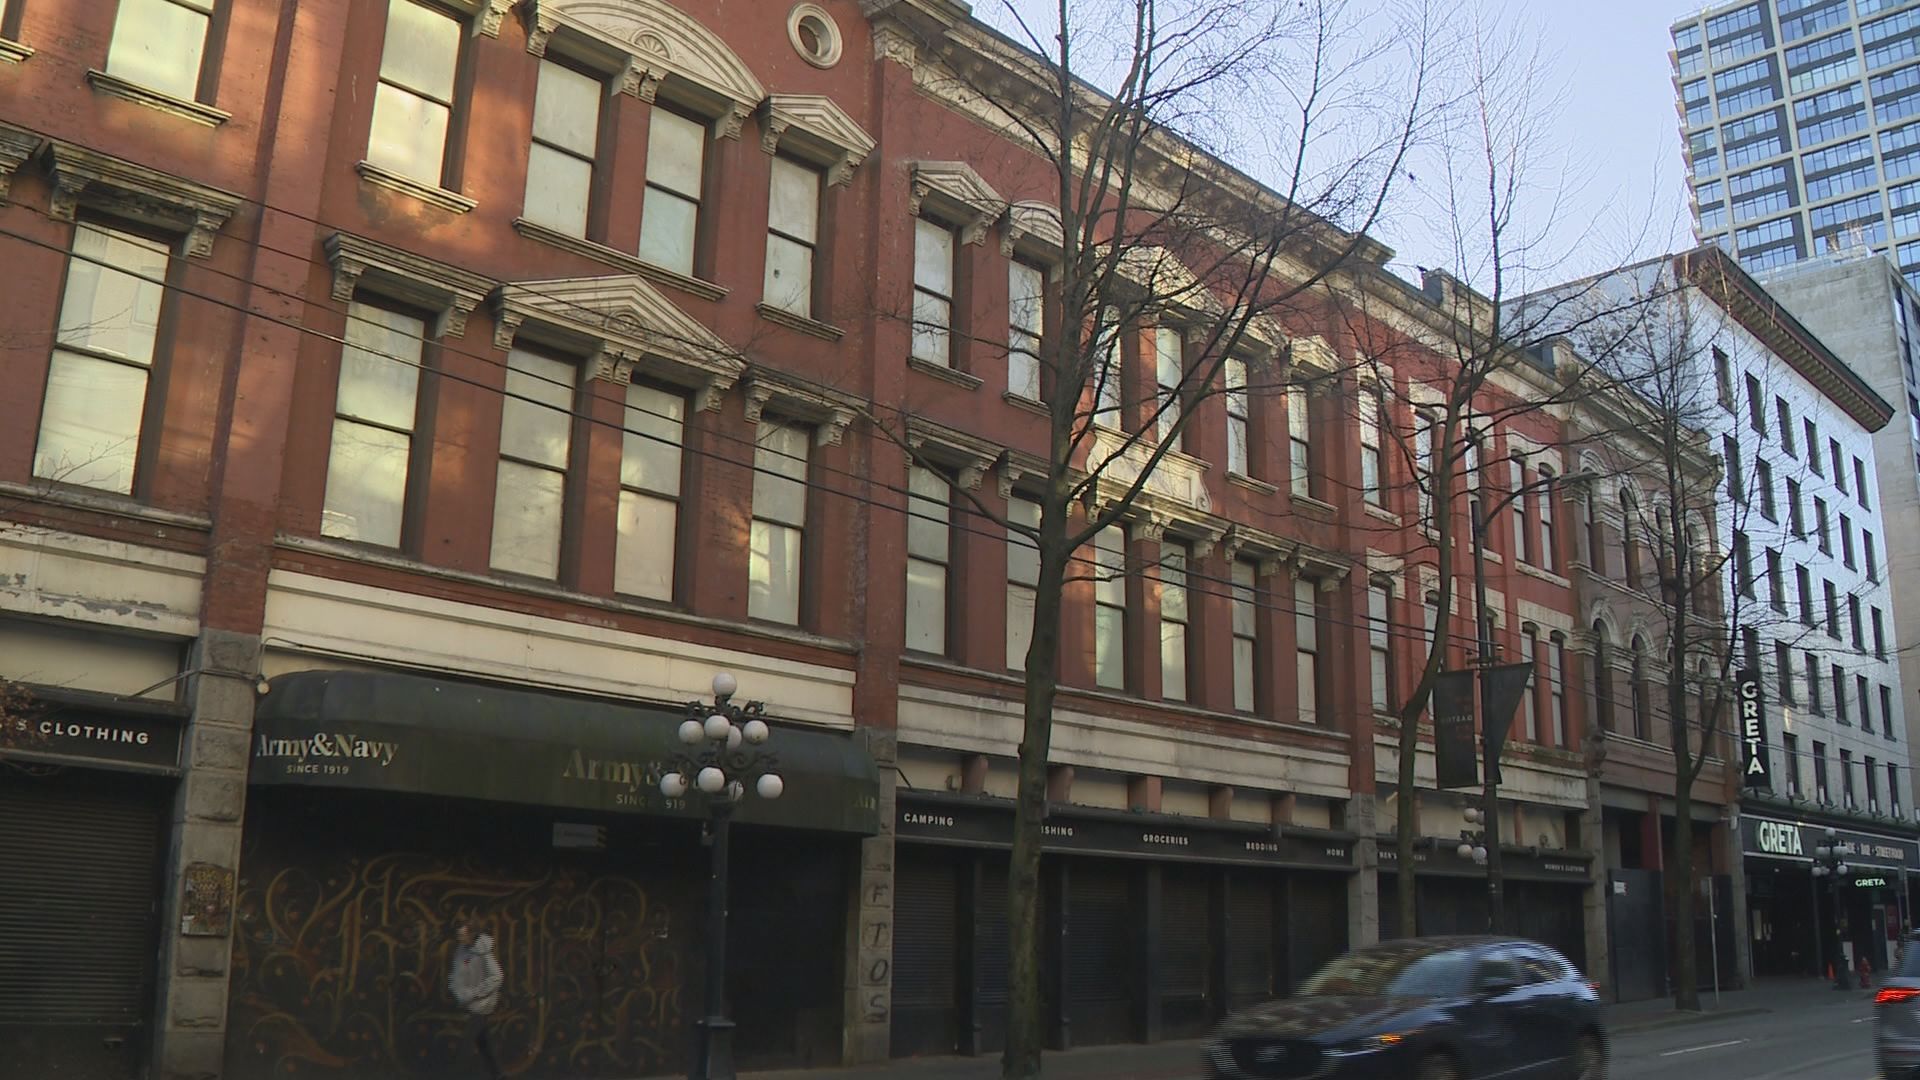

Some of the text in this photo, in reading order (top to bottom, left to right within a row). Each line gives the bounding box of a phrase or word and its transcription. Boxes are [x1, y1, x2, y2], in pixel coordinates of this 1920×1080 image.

[39, 721, 150, 745] CLOTHING
[1741, 681, 1765, 775] GRETA
[256, 732, 399, 767] Army&Navy
[286, 764, 348, 775] SINCE 1919
[560, 749, 698, 793] Army&
[616, 793, 687, 810] SINC 919
[904, 812, 954, 827] CAMPING
[1041, 825, 1073, 837] ISHING
[1758, 821, 1803, 856] GRETA
[1142, 833, 1188, 846] GROCERIES
[1245, 842, 1278, 852] BEDDING
[1326, 848, 1344, 857] HOME
[1854, 878, 1887, 888] GRETA
